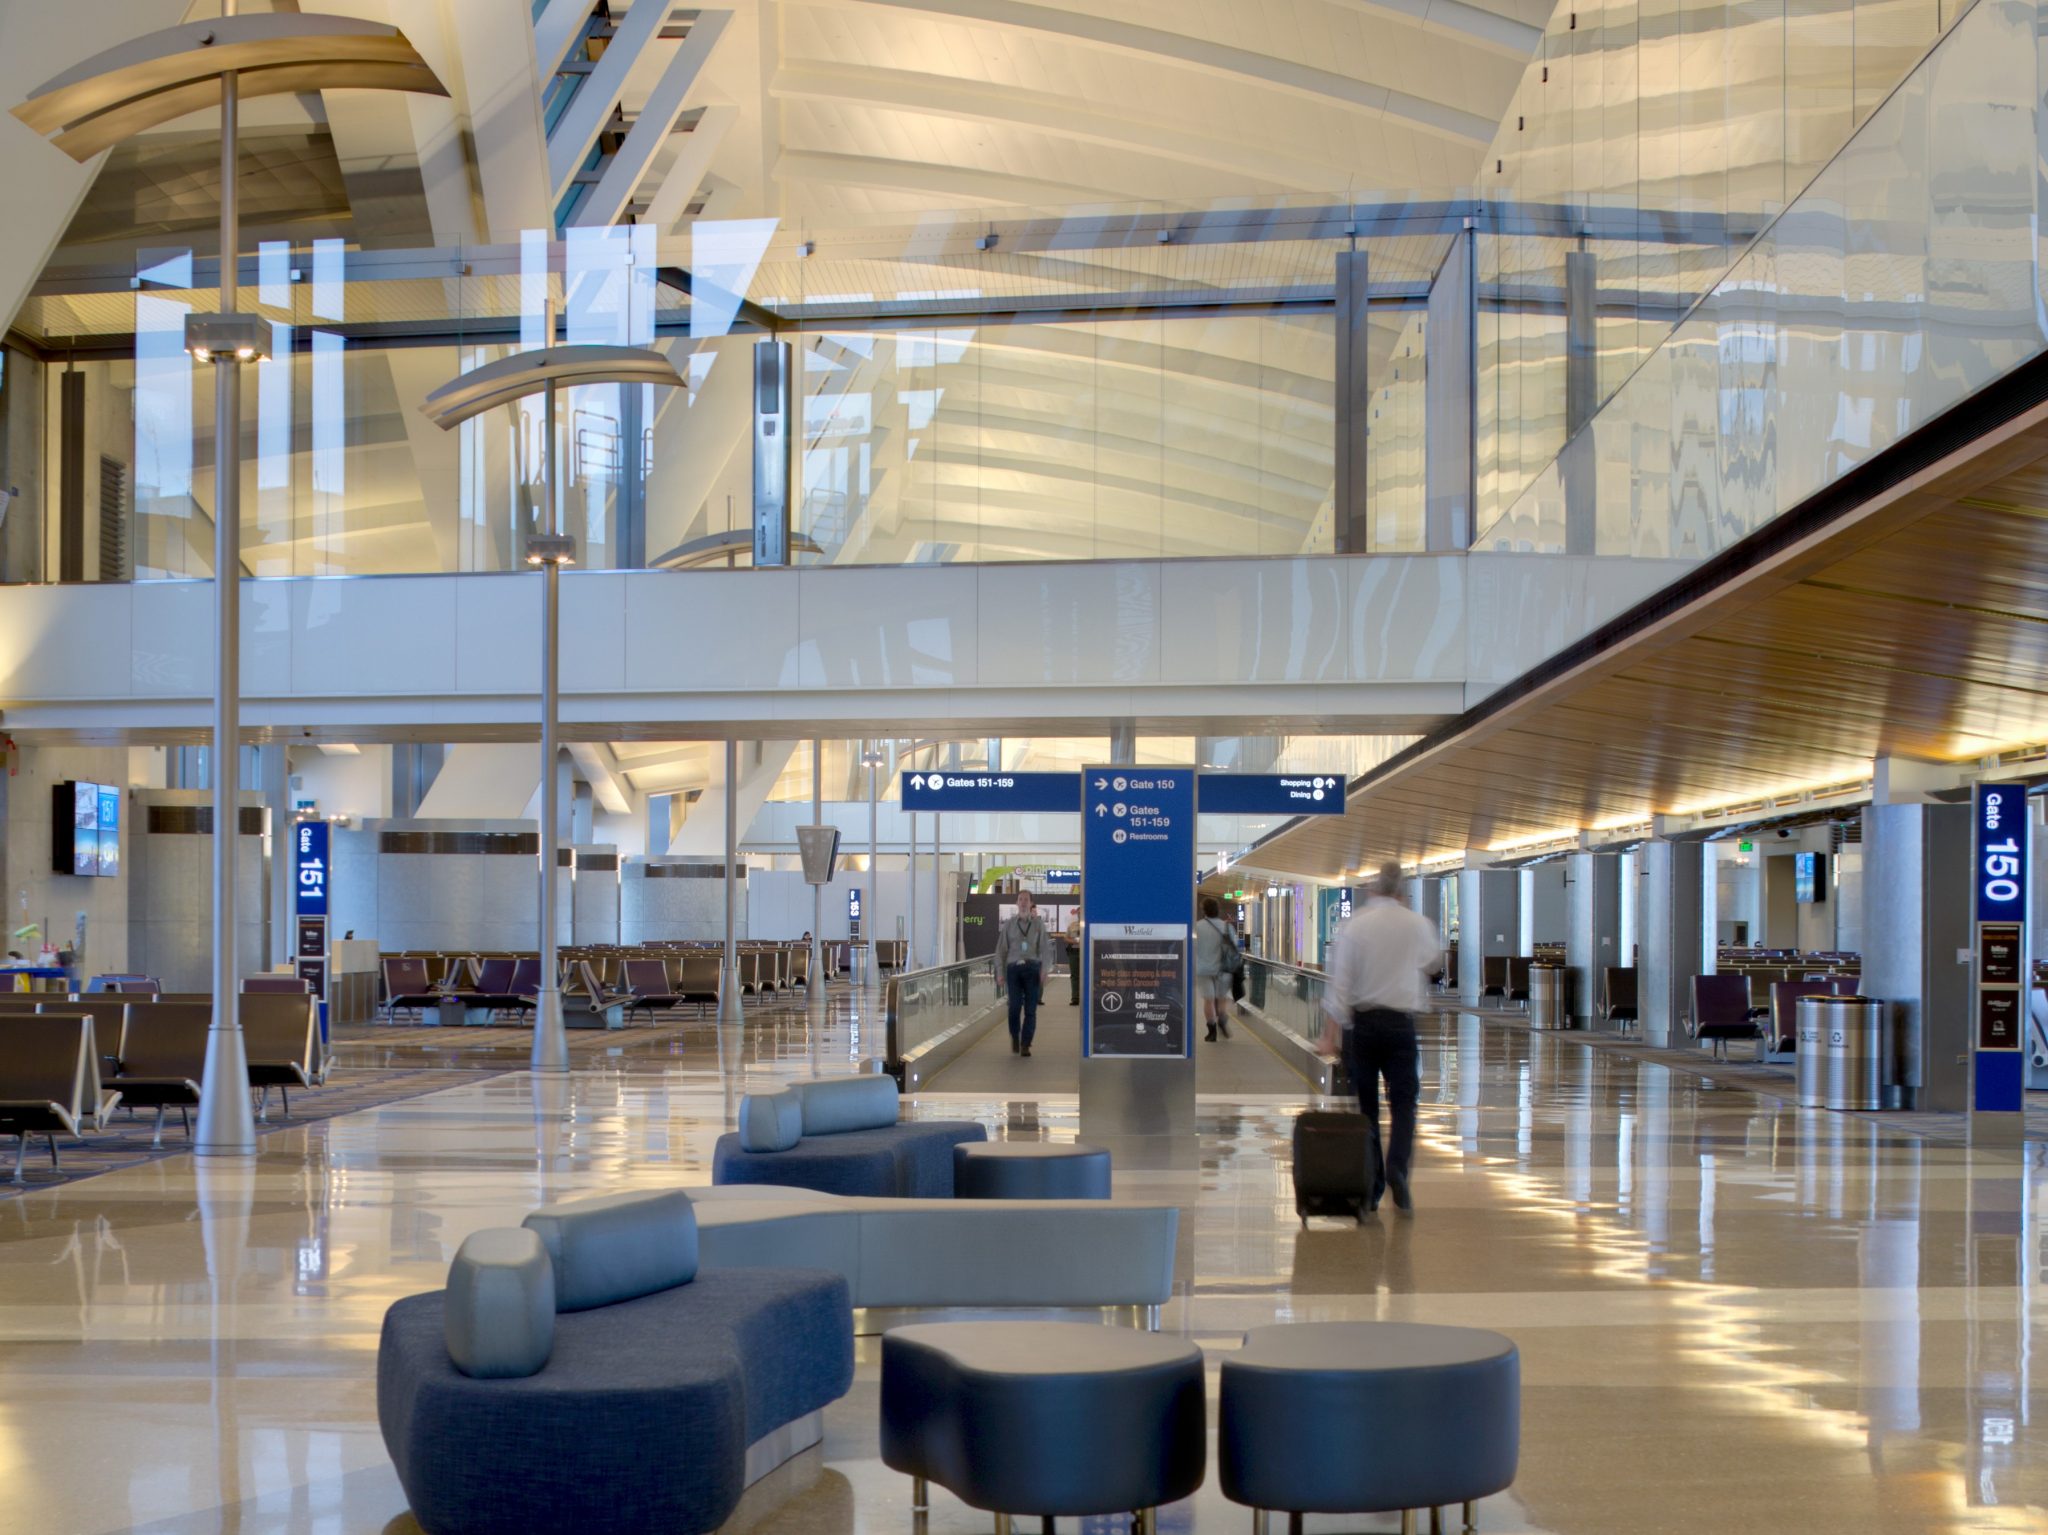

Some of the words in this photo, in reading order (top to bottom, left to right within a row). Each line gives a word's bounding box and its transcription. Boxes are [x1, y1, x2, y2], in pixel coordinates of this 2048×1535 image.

[946, 778, 975, 787] Gates
[977, 778, 1014, 787] 151-159
[1130, 780, 1154, 789] Gate
[1157, 780, 1175, 789] 150
[1280, 779, 1311, 788] Shopping
[1290, 791, 1311, 799] Dining
[1130, 805, 1160, 815] Gates
[1986, 793, 2003, 830] Gate
[1130, 817, 1170, 827] 151-159
[300, 827, 313, 853] Gate
[1985, 838, 2019, 902] 150
[300, 857, 324, 897] 151
[1341, 900, 1351, 918] 152
[1135, 991, 1155, 1000] bliss
